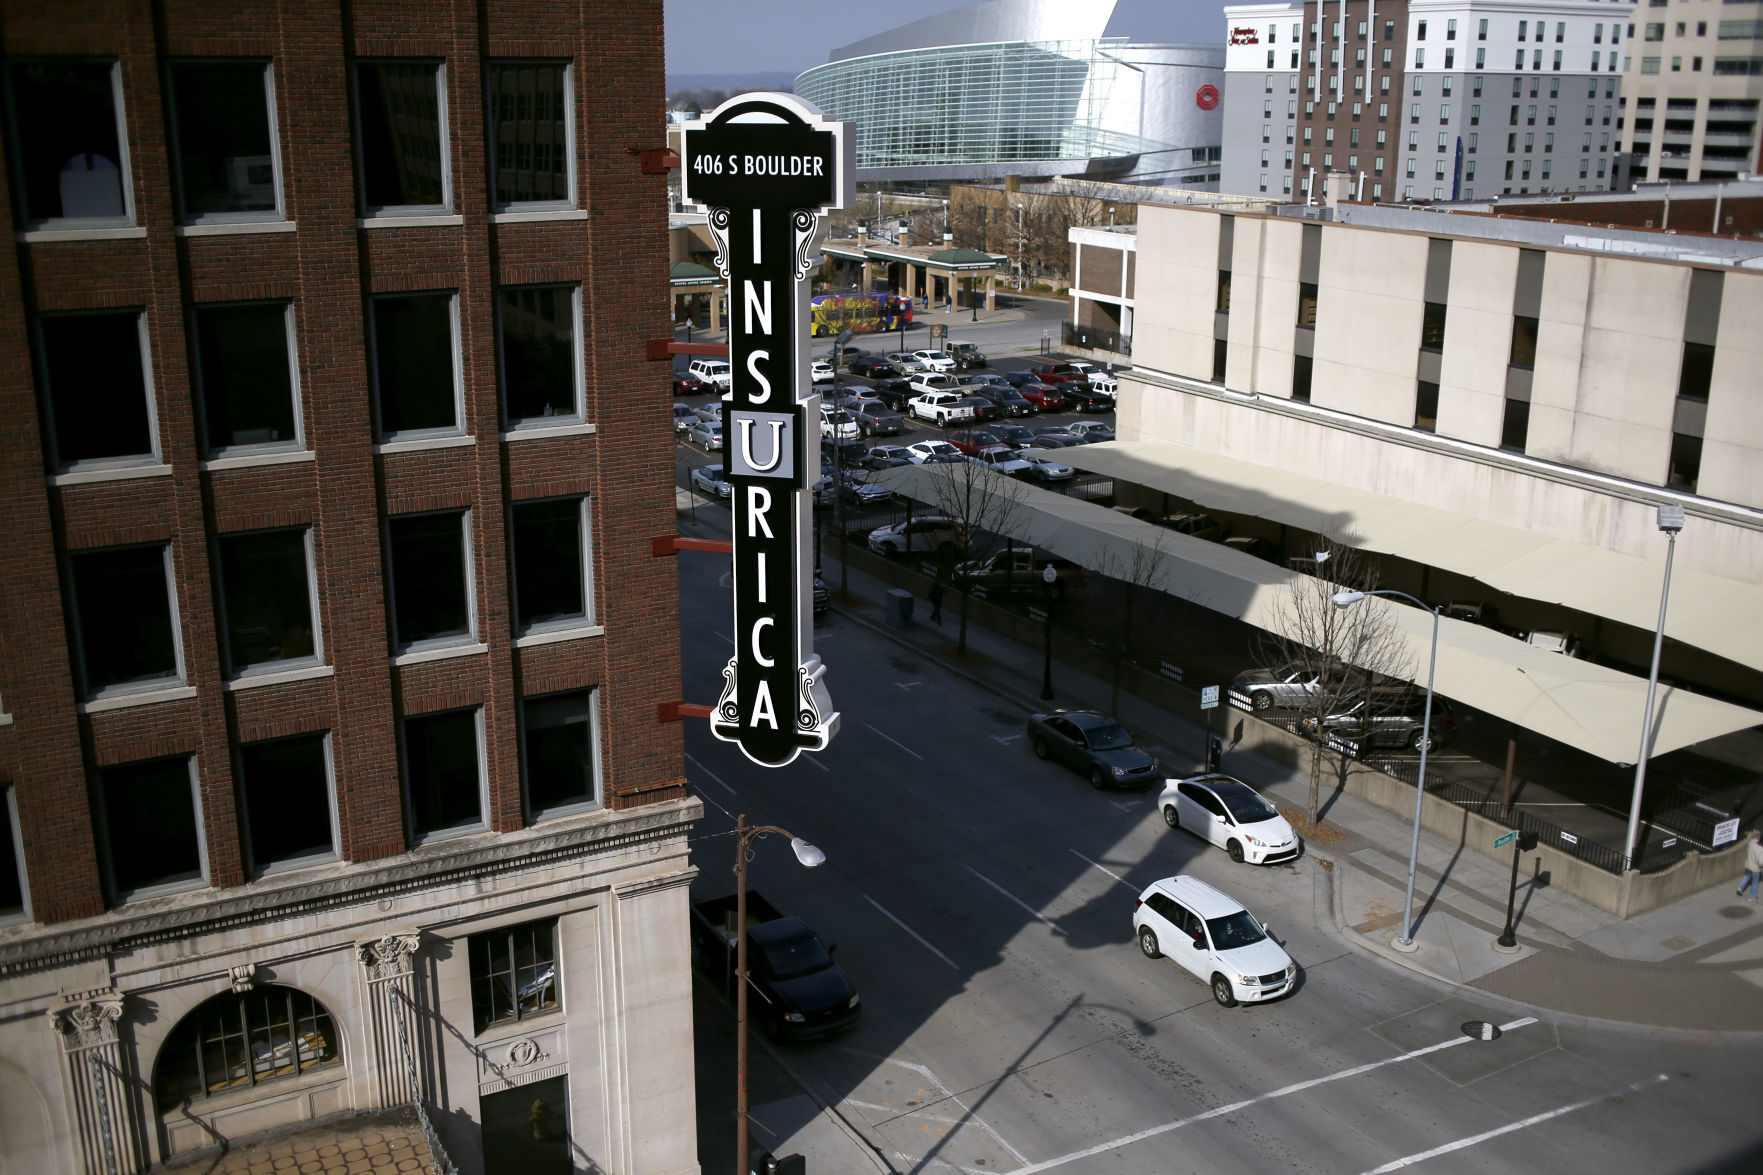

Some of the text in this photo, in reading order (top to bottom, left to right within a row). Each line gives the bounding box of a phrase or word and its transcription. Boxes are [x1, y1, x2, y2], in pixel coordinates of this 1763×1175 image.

[693, 154, 824, 176] 406 S BOULDER
[737, 208, 789, 731] INSURICA
